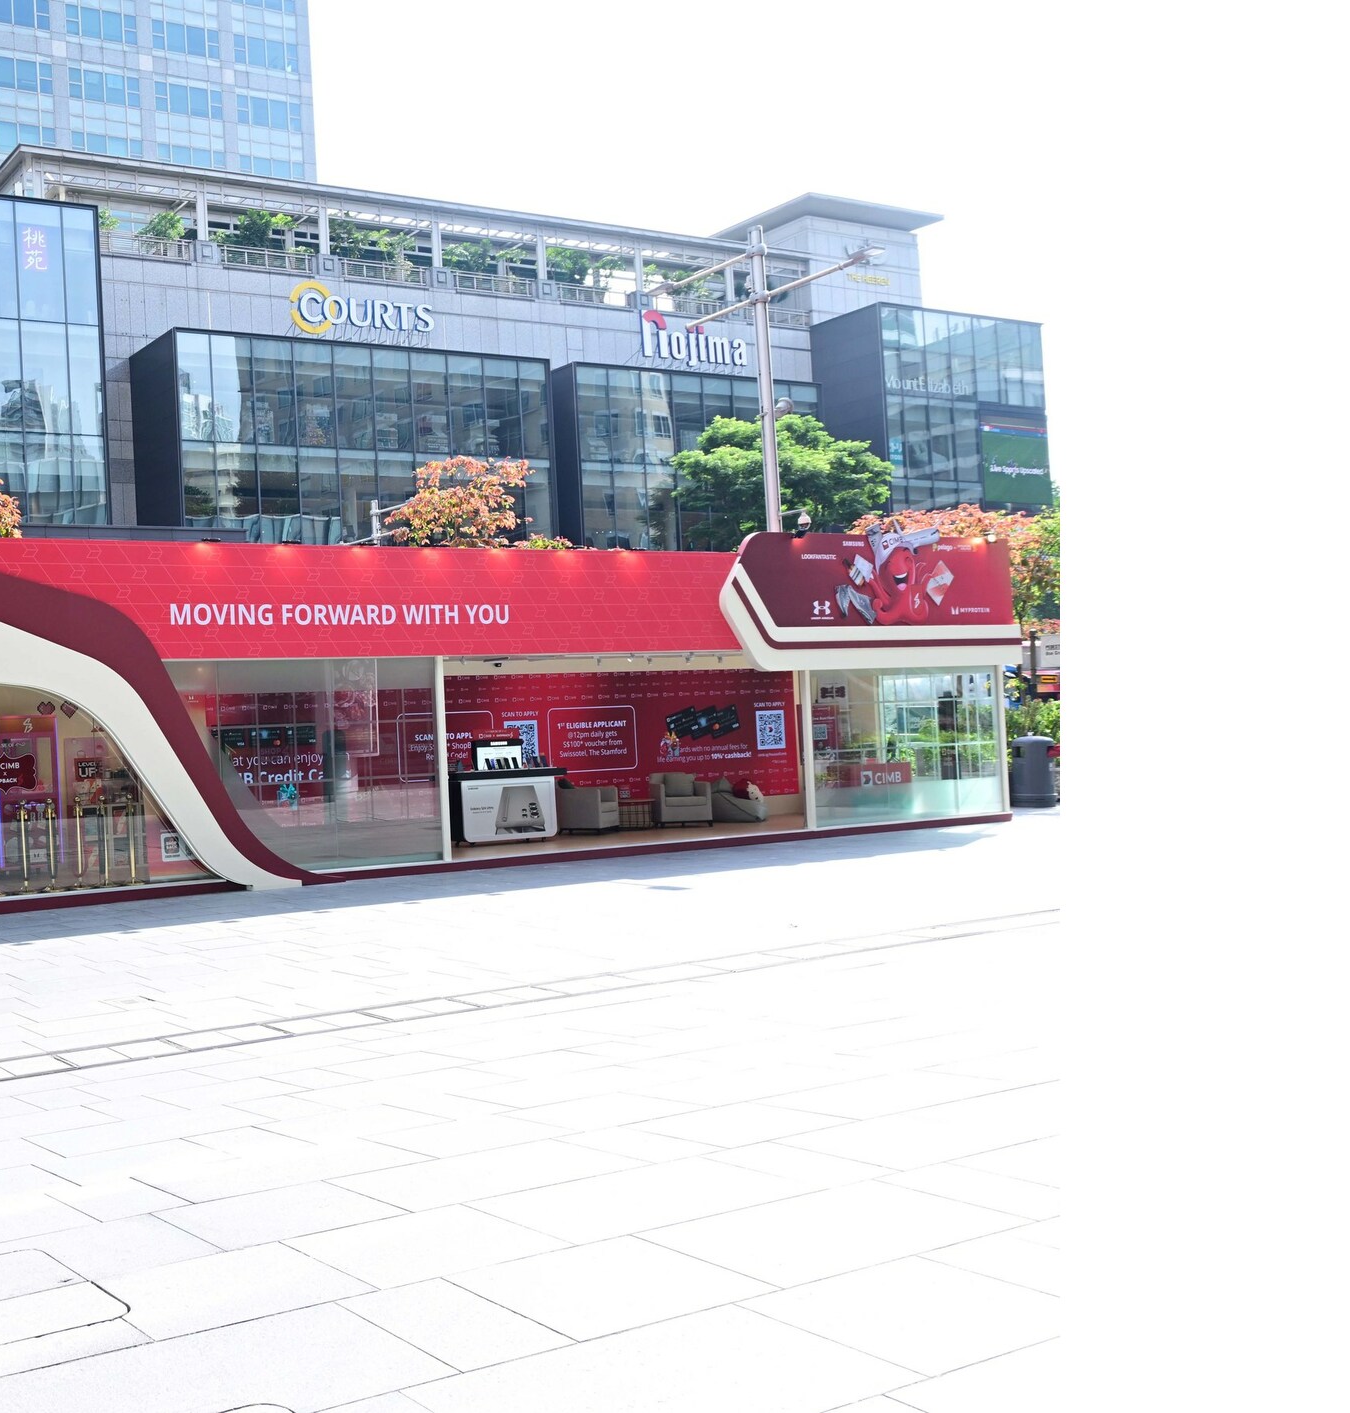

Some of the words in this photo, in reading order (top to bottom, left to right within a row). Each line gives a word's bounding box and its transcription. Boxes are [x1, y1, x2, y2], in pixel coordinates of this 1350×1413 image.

[22, 227, 47, 269] 桃苑
[298, 292, 435, 332] COURTS
[640, 310, 748, 367] nojima
[170, 603, 273, 625] MOVING
[282, 604, 397, 625] FORWARD
[402, 604, 459, 625] WITH
[466, 604, 510, 625] YOU
[593, 720, 626, 728] APPLICANT
[568, 731, 589, 739] @12pm
[271, 755, 291, 765] can
[294, 752, 324, 766] enjoy
[601, 748, 627, 756] Stamford
[0, 762, 20, 770] CIMB
[259, 769, 304, 783] Credit
[875, 772, 902, 784] CIMB
